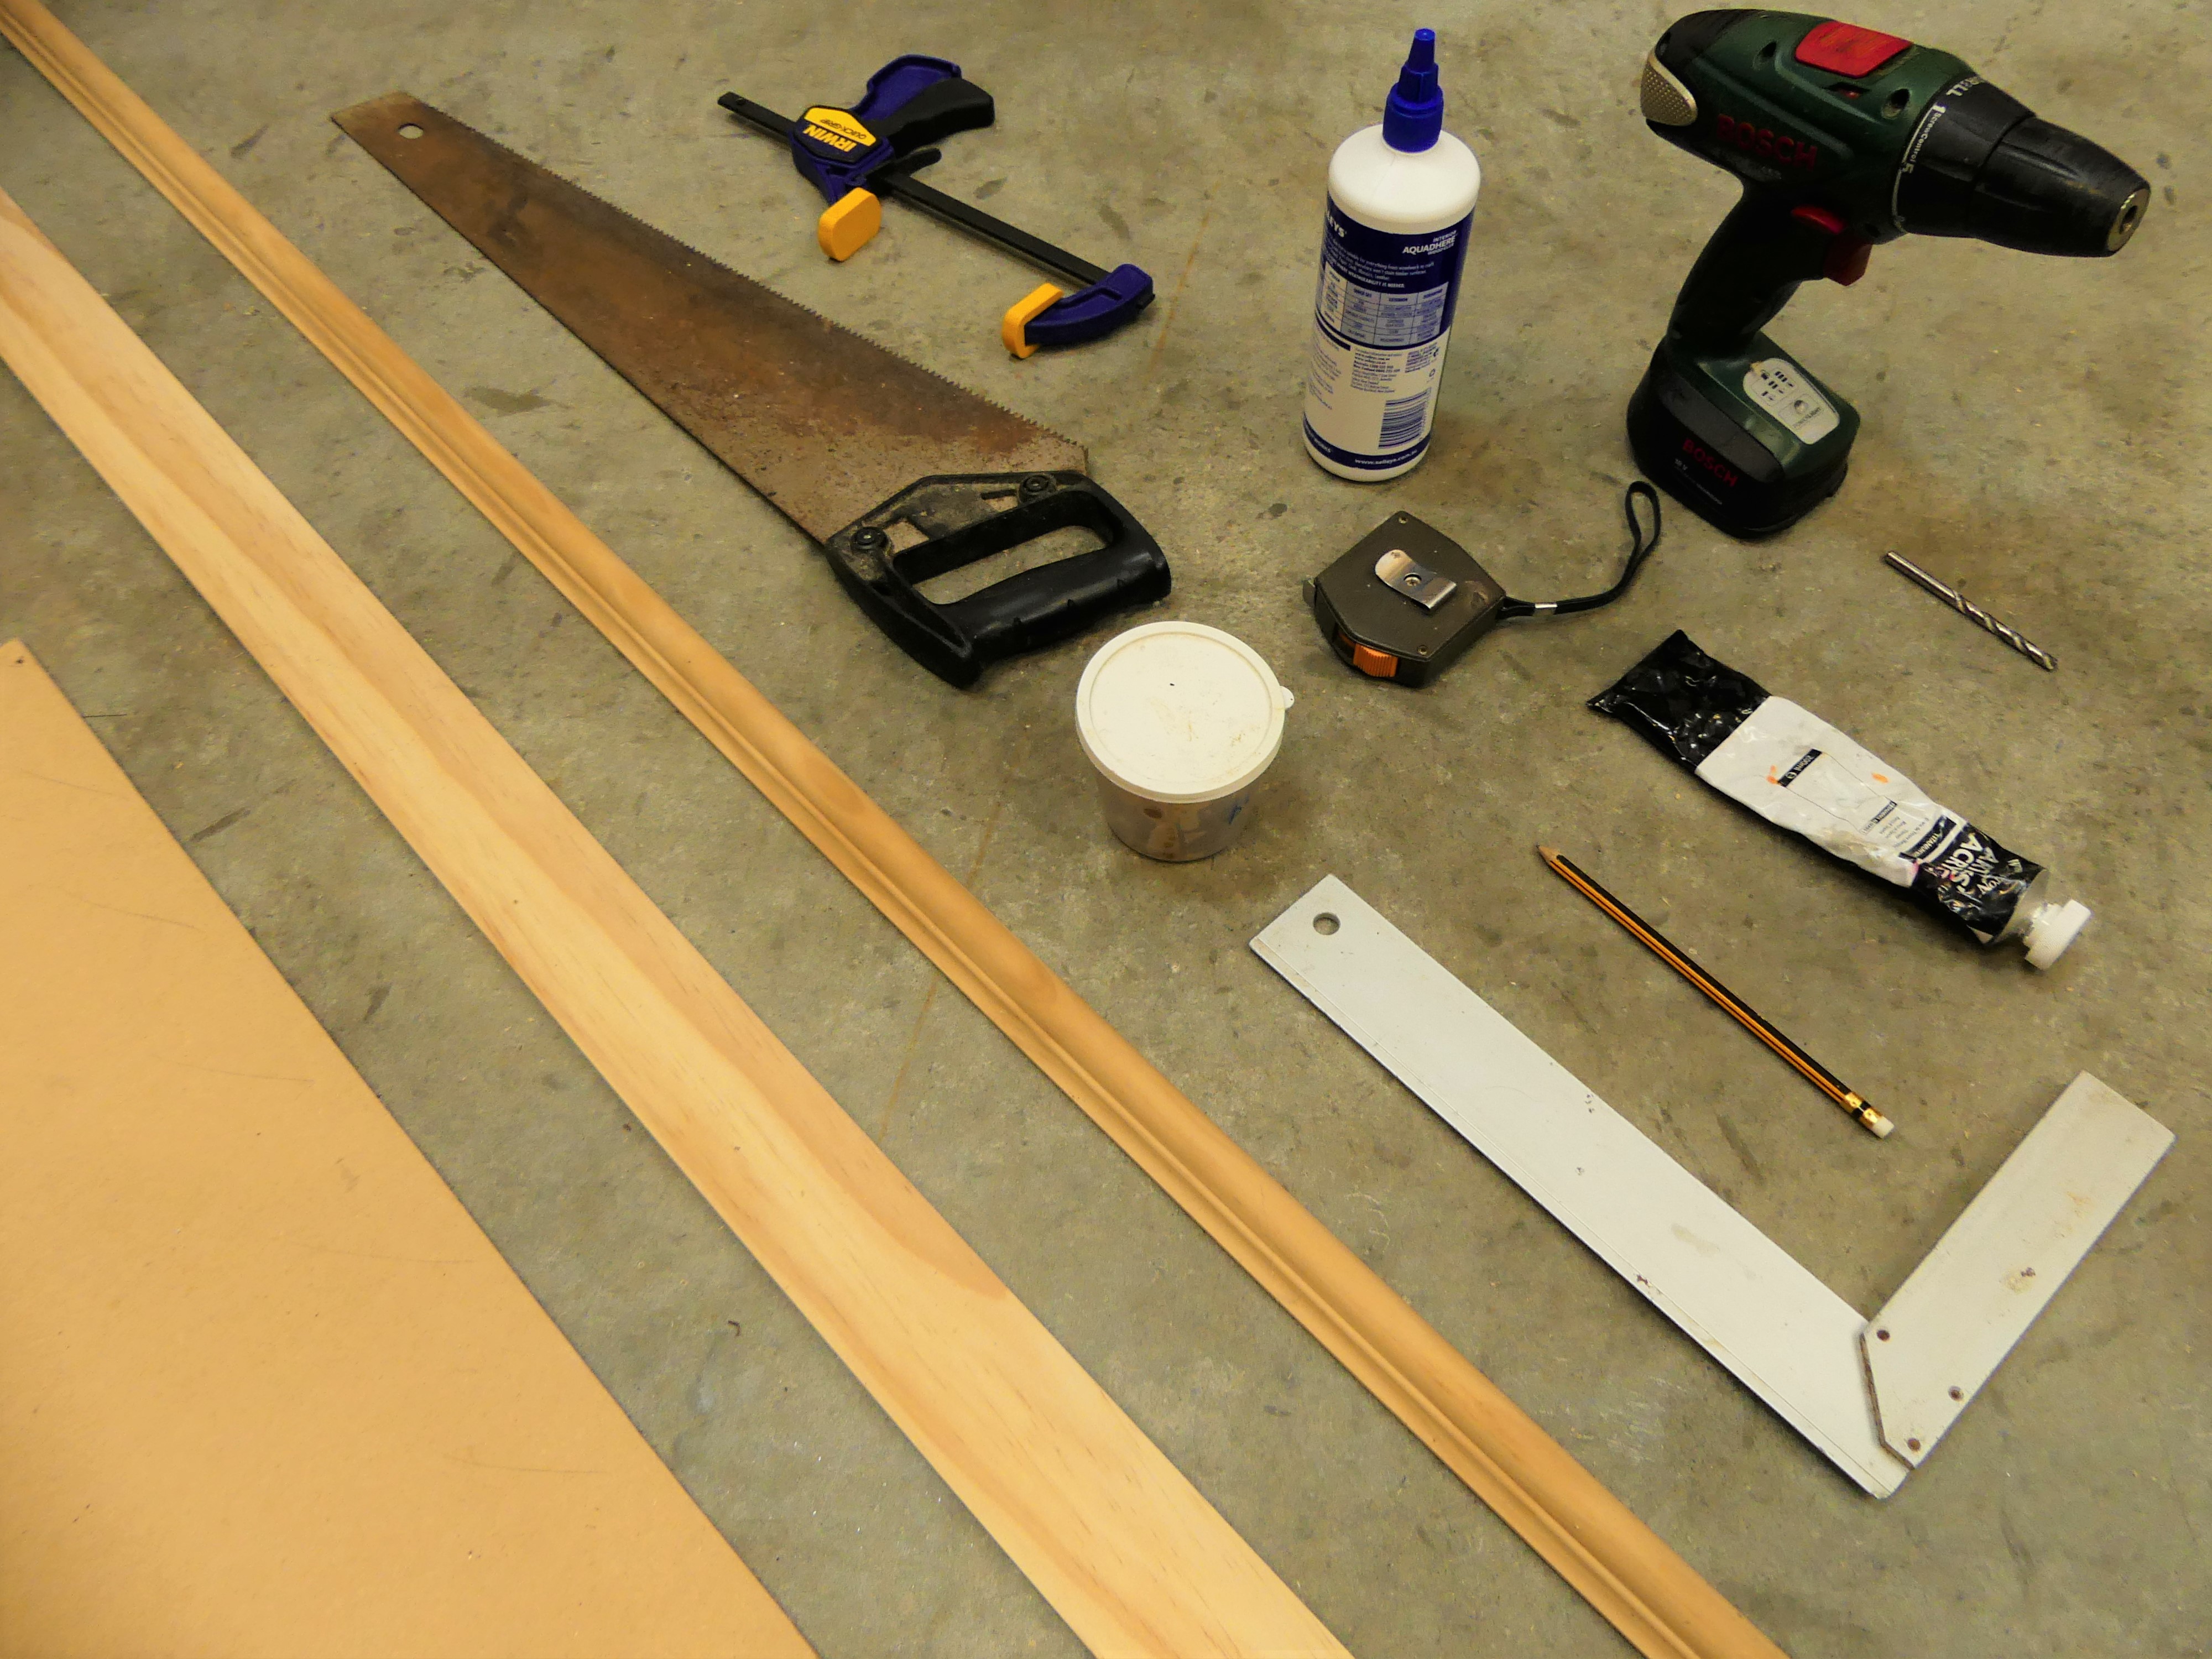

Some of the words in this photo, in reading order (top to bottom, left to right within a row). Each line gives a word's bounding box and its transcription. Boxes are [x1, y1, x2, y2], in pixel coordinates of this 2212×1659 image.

[802, 124, 858, 153] IRWIN
[820, 118, 867, 140] QUICK-GRIP
[1717, 113, 1818, 172] BOSCH
[1402, 236, 1456, 255] AQUADHERE
[1682, 437, 1739, 487] BOSCH
